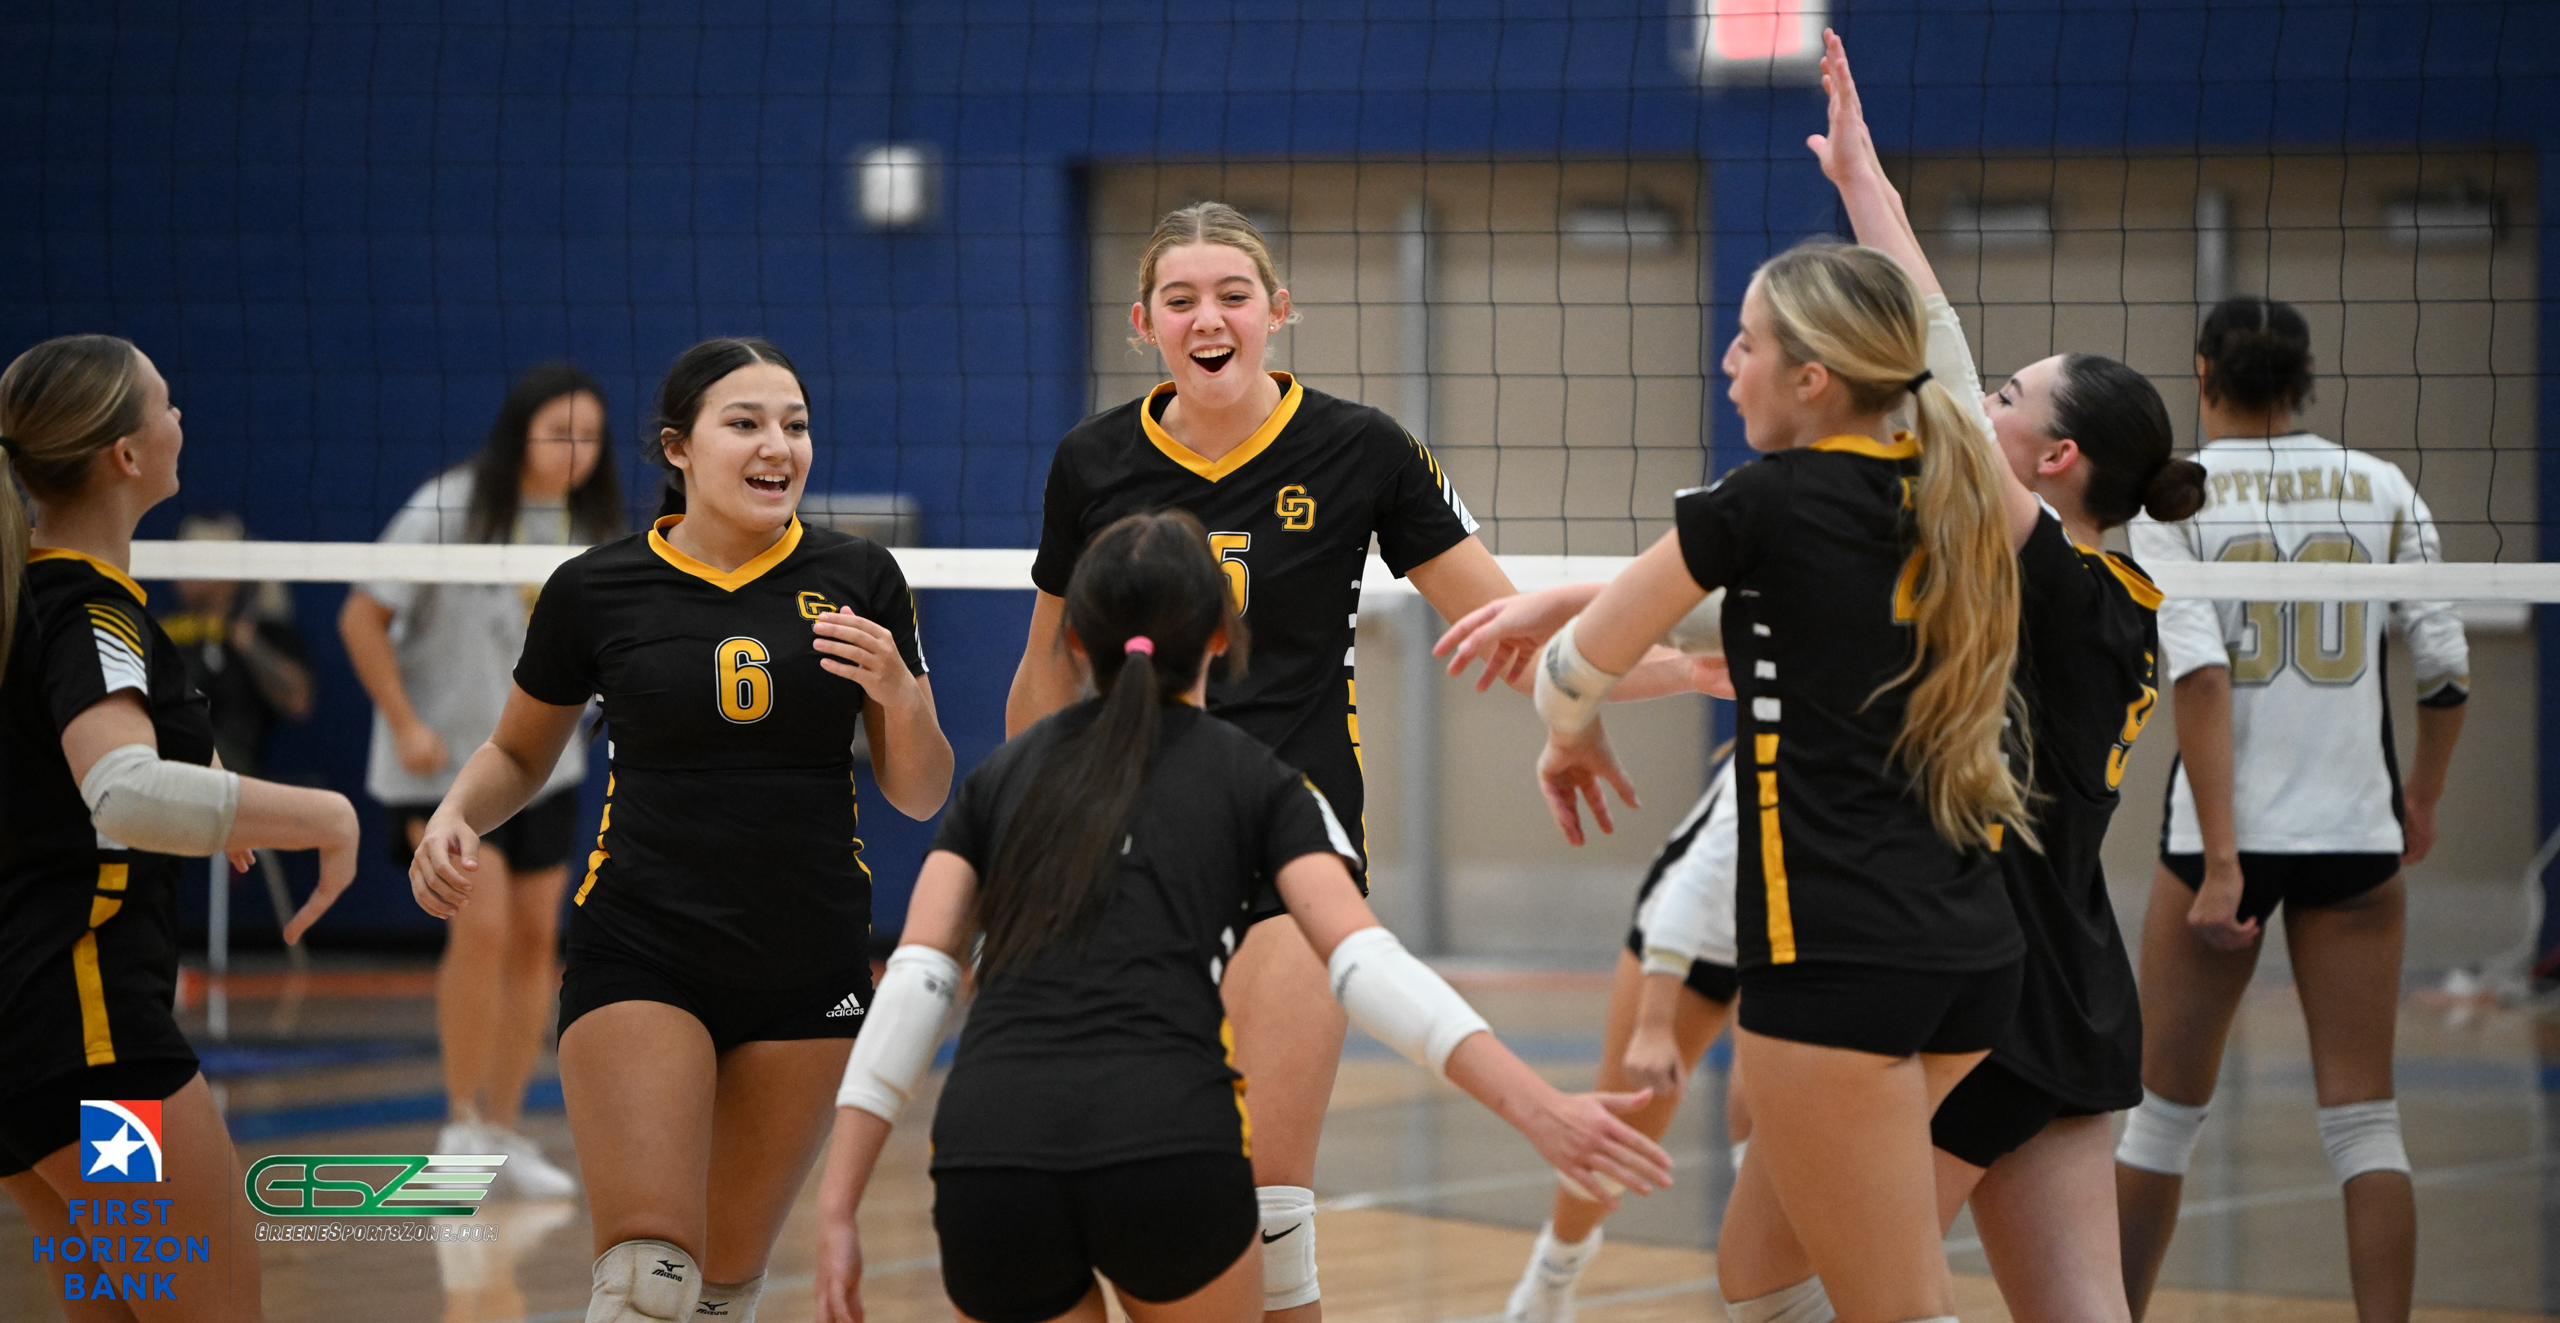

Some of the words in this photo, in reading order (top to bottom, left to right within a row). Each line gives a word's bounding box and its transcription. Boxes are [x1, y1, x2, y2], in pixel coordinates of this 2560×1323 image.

[1275, 483, 1317, 532] CD
[2206, 467, 2374, 506] PPERMAN
[2214, 531, 2373, 687] 30
[714, 636, 774, 725] 6
[826, 1007, 865, 1017] adidas
